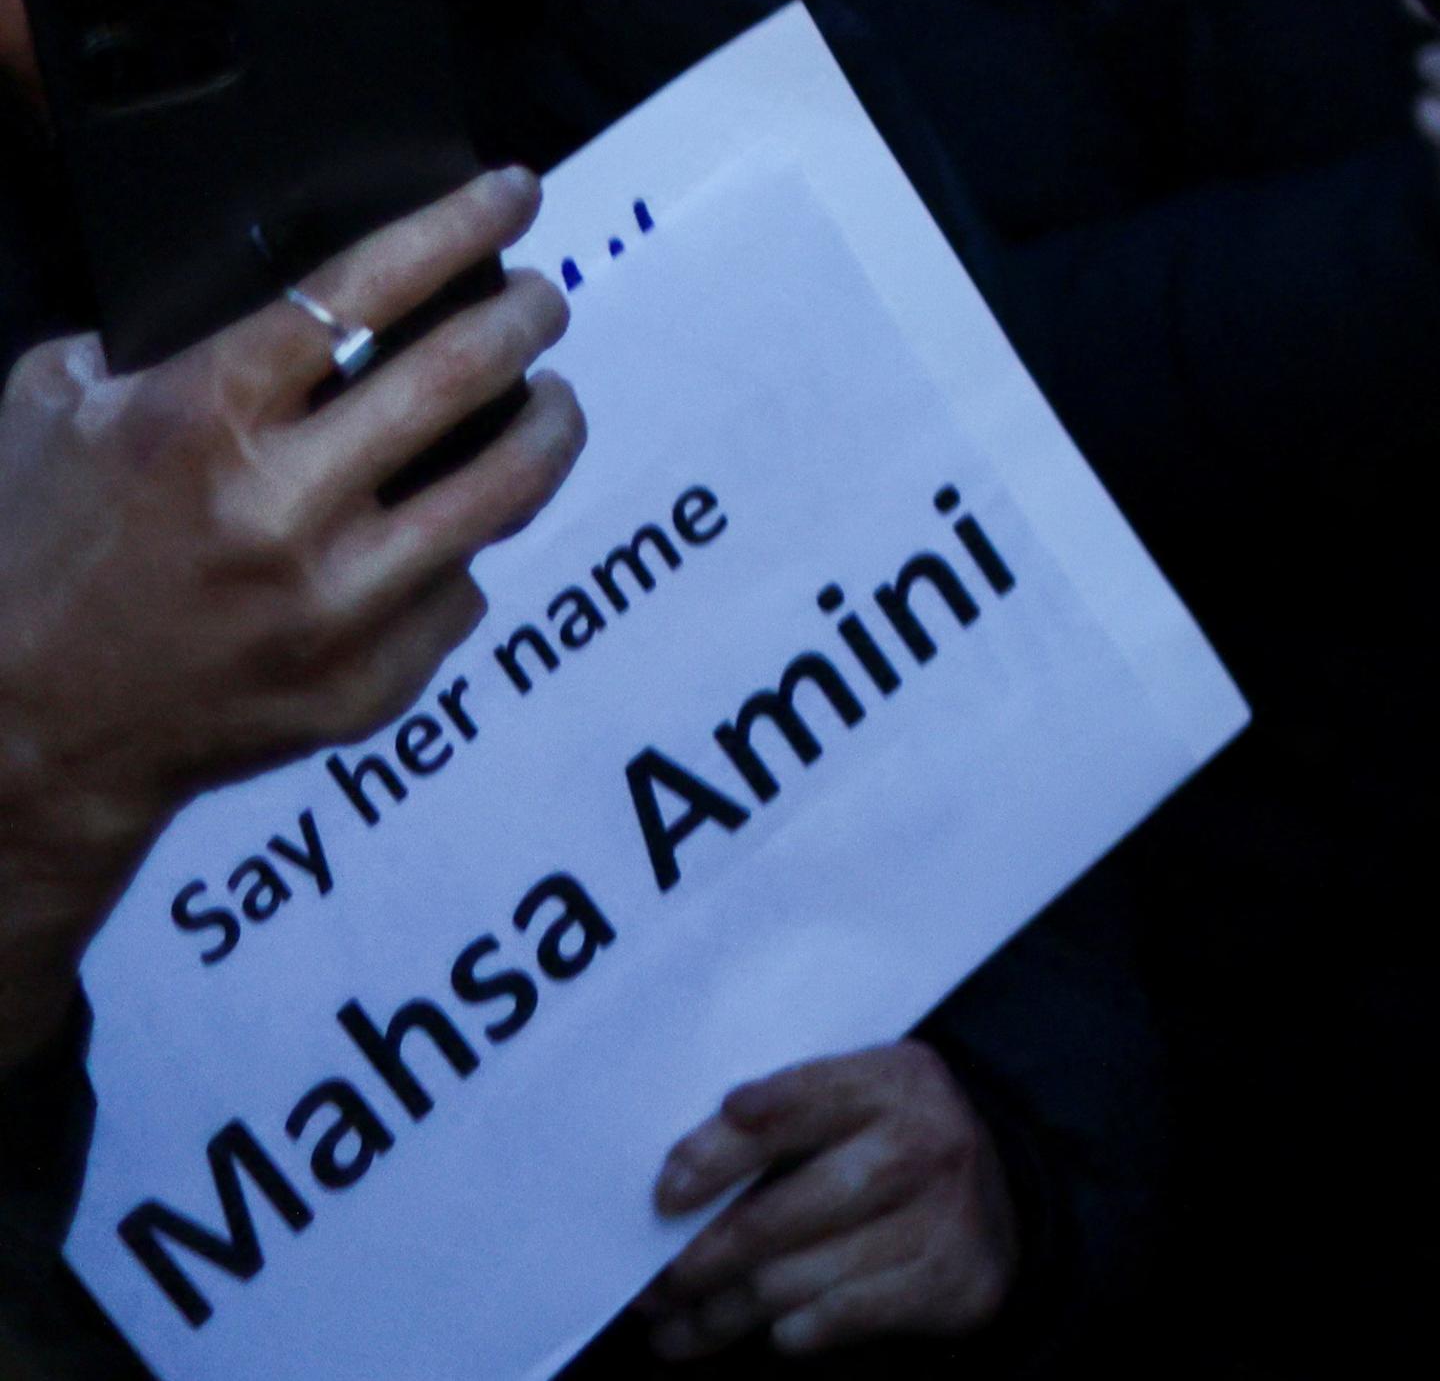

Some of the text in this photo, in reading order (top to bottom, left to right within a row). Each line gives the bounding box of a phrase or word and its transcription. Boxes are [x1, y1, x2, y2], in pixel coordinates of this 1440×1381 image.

[116, 484, 1016, 1331] Mahsa Amini
[171, 484, 728, 965] Say her name
